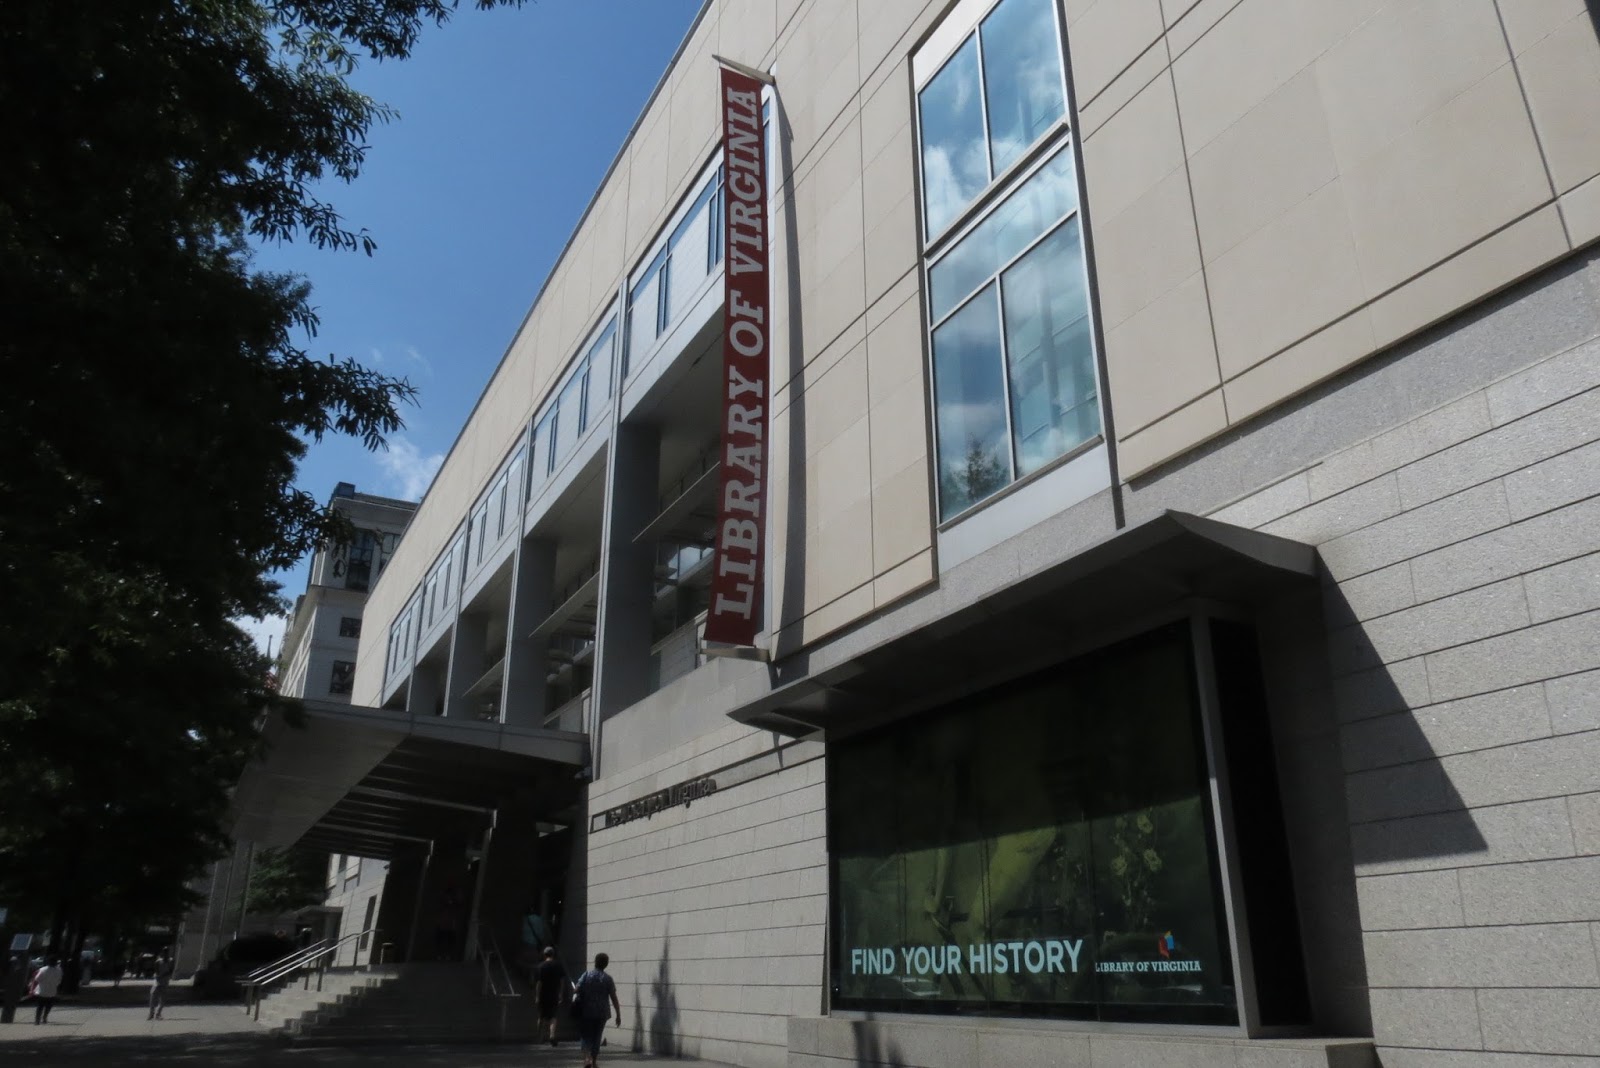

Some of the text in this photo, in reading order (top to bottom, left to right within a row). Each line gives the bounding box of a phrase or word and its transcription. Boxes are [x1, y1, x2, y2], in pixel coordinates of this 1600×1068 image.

[715, 87, 764, 619] LIBRARY OF VIRGINIA
[851, 939, 1083, 975] FIND YOUR HISTORY
[1095, 960, 1202, 973] LIBRARY OF VIRGINIA
